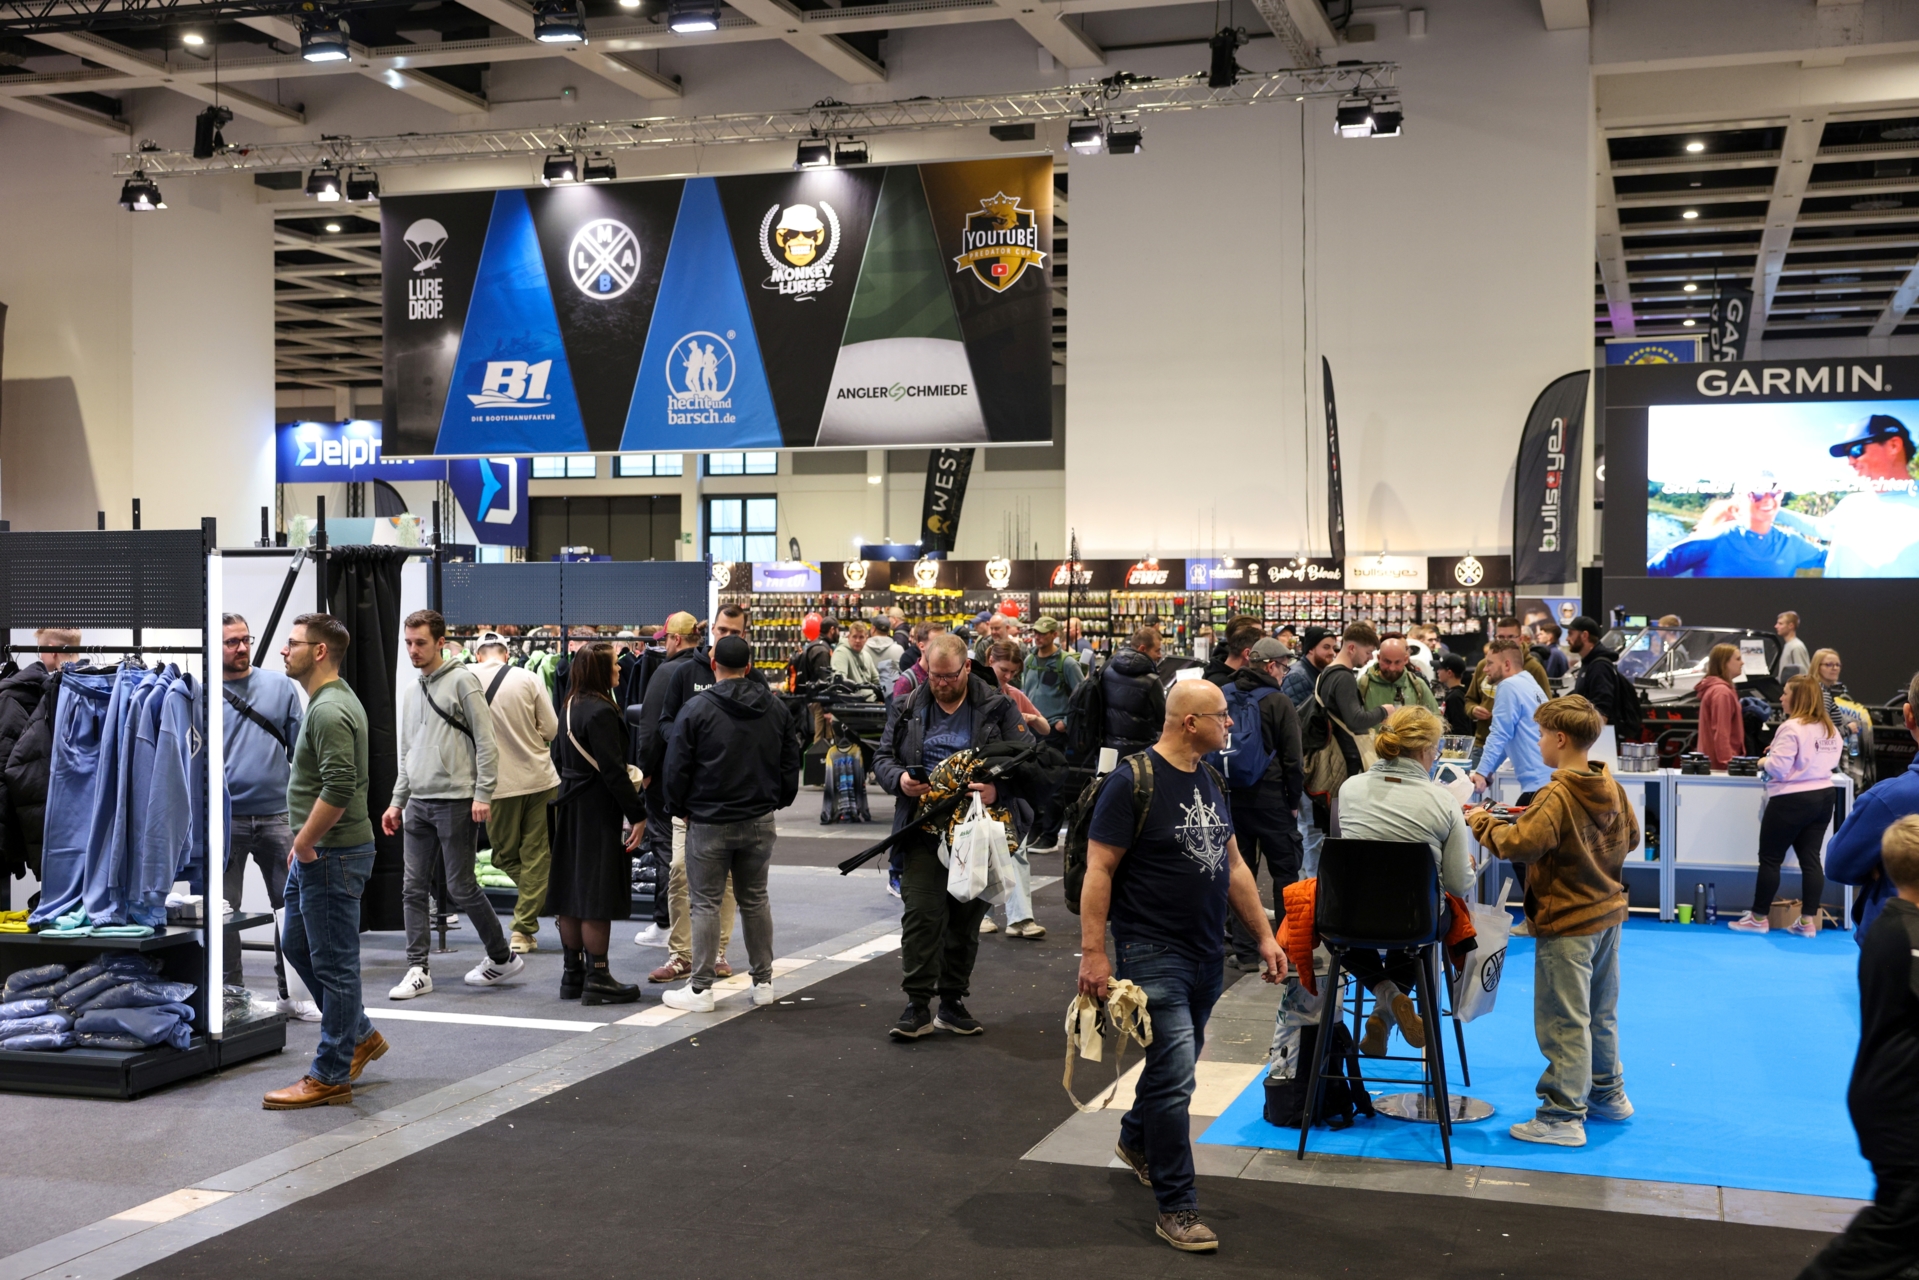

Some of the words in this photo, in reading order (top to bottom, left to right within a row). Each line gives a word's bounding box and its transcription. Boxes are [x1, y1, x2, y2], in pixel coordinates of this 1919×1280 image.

[967, 228, 1034, 249] YOUTUBE
[969, 247, 1011, 259] PREDATOR
[1015, 247, 1031, 256] CUP
[770, 264, 834, 282] MONKEY
[409, 278, 443, 300] LURE
[779, 278, 827, 295] LURES
[409, 299, 443, 320] DROP.
[482, 359, 553, 400] B1
[1696, 365, 1884, 397] GARMIN
[667, 394, 711, 410] hecht
[712, 398, 732, 409] und
[485, 413, 556, 422] BOOTSMANUFAKTUR
[667, 408, 736, 425] barsch.de
[1128, 570, 1169, 585] CWC
[1293, 560, 1307, 582] of
